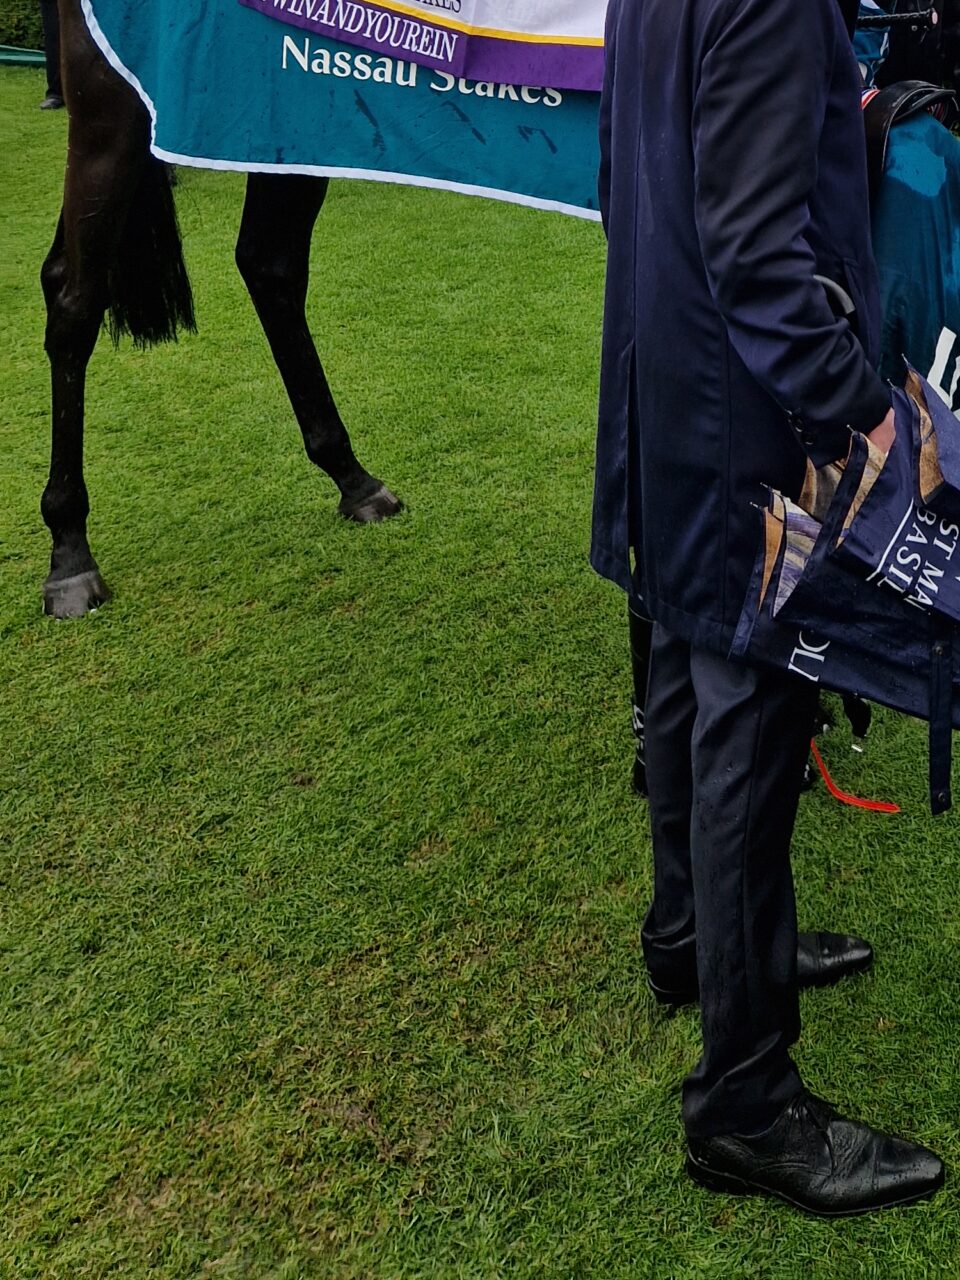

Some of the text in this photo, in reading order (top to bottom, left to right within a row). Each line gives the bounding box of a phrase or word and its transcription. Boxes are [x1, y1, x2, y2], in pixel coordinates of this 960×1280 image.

[281, 35, 417, 89] Nassau
[904, 518, 960, 612] ST MA
